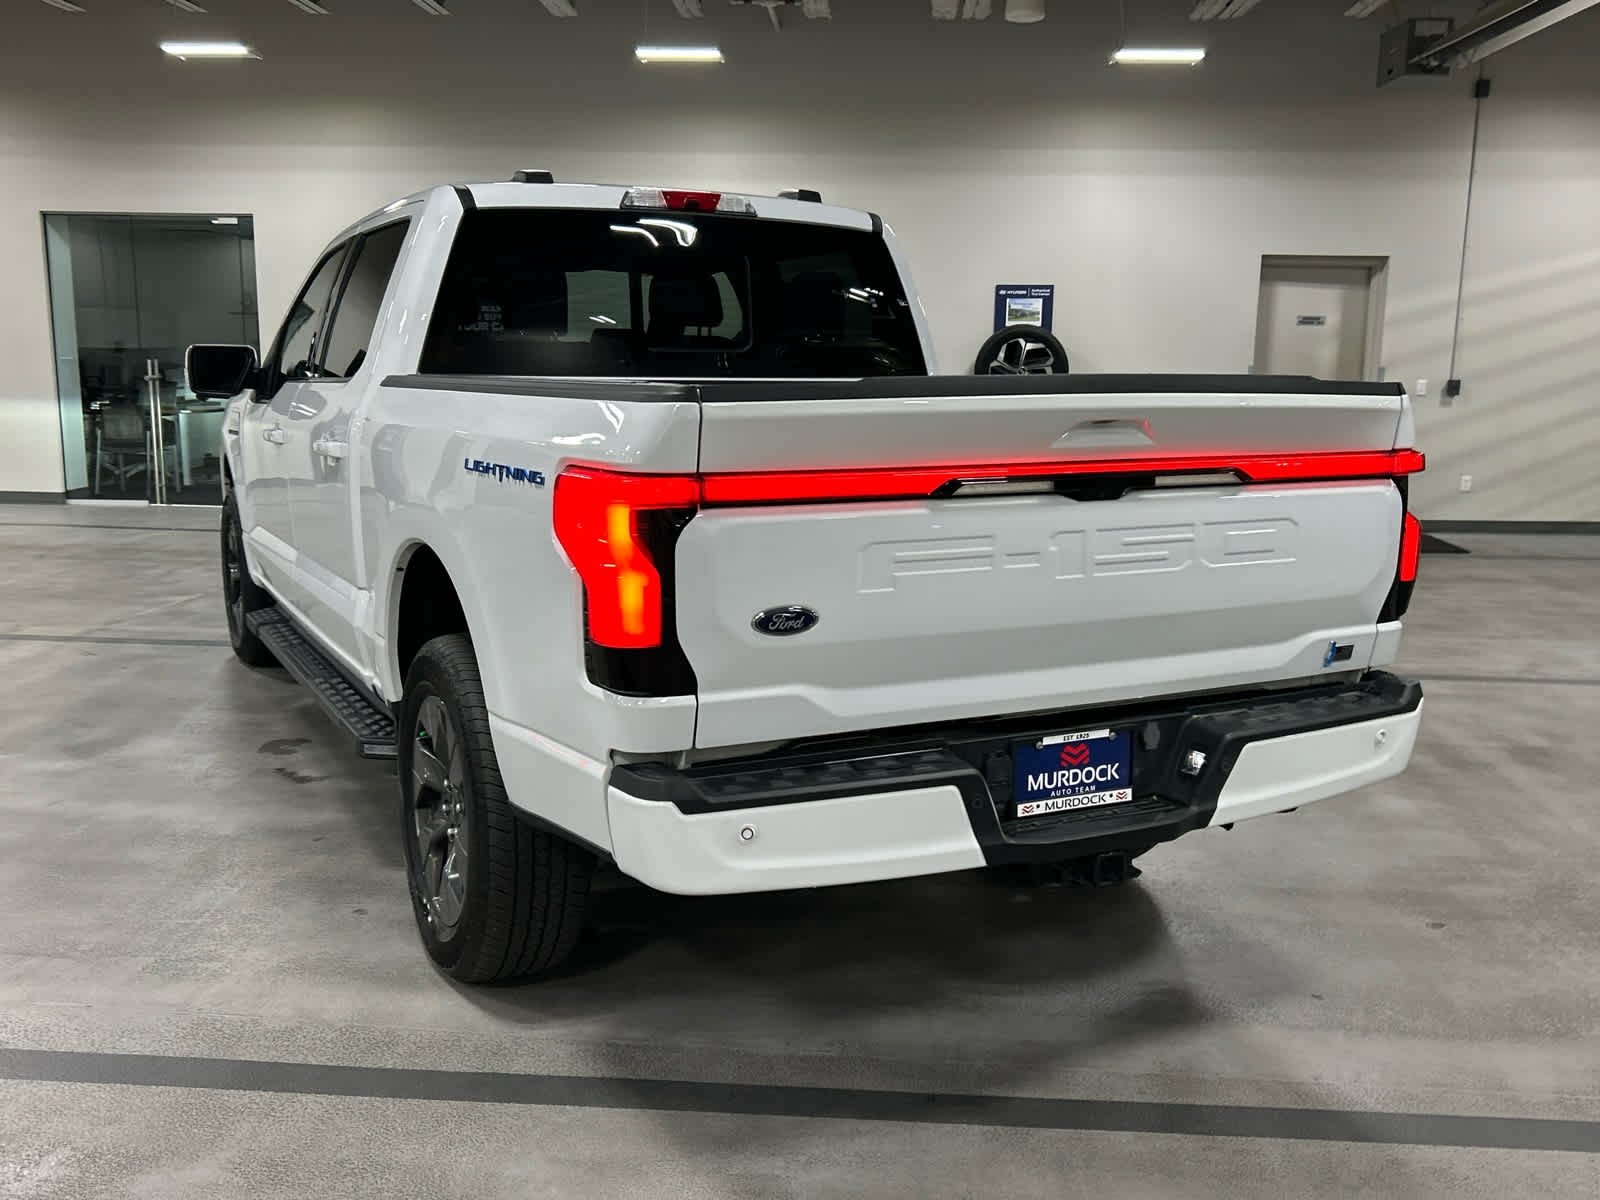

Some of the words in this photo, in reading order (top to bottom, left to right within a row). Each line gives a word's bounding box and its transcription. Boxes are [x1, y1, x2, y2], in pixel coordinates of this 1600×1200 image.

[464, 457, 546, 486] LIGHTNING
[857, 517, 1299, 593] F-150
[768, 612, 806, 630] Ford
[1027, 762, 1120, 792] MURDOCK
[1045, 793, 1107, 812] MURDOCK
[1050, 787, 1072, 797] AUTO
[1075, 785, 1096, 793] TEAM
